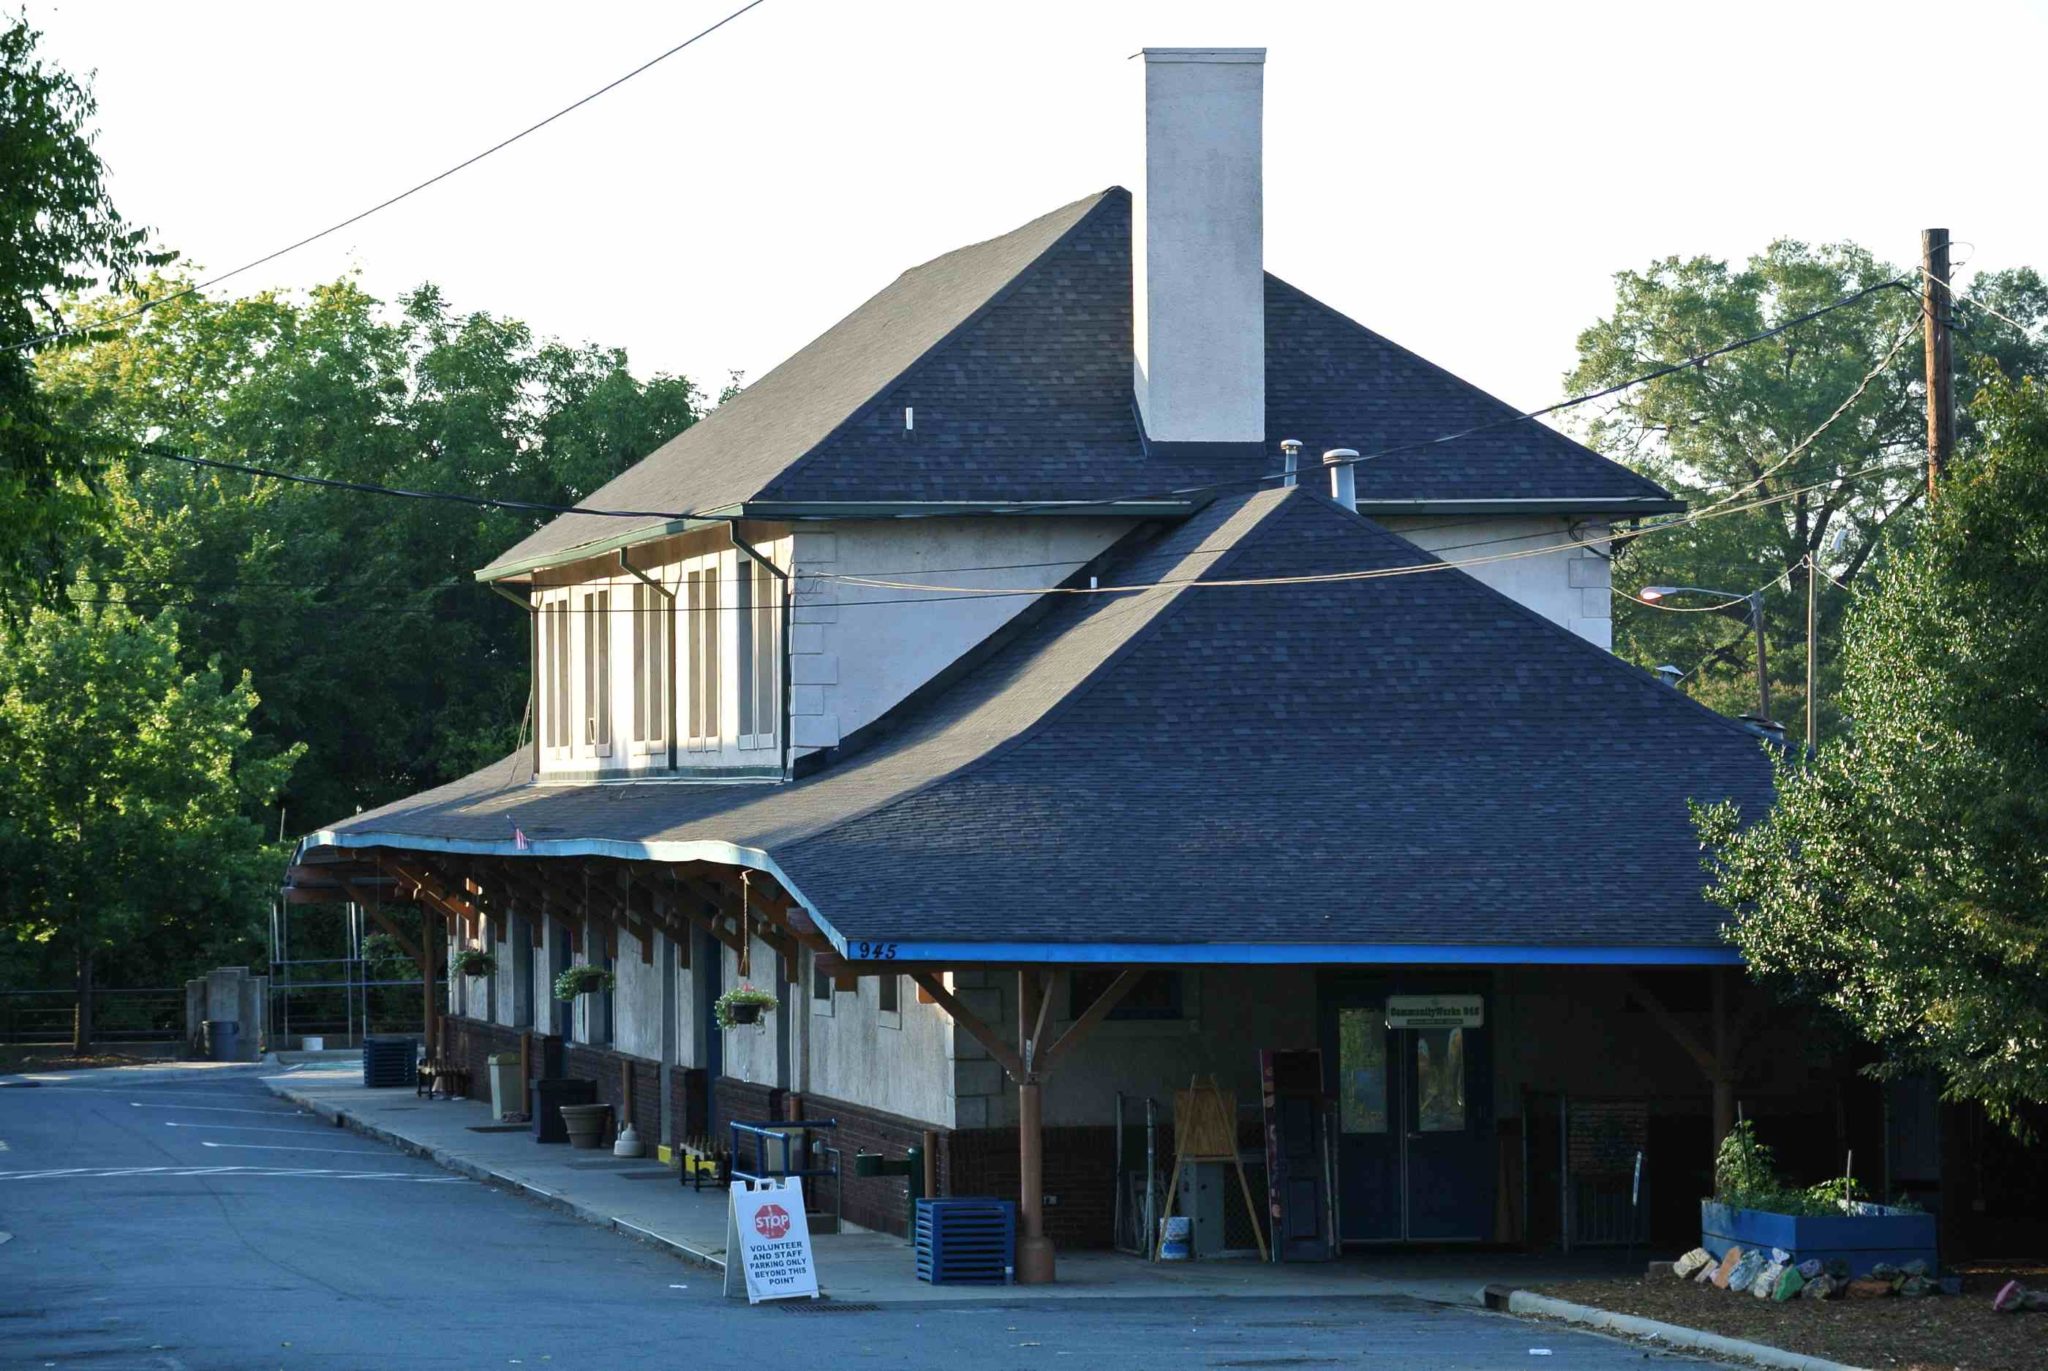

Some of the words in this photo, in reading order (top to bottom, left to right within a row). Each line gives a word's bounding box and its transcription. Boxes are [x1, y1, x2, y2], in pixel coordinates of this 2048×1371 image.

[859, 941, 898, 959] 945
[756, 1215, 789, 1228] STOP
[750, 1241, 803, 1252] VOLUNTEER
[753, 1252, 772, 1261] AND
[775, 1250, 802, 1259] STAFF
[750, 1260, 784, 1270] PARKING
[786, 1258, 807, 1266] ONLY
[755, 1269, 787, 1279] BEYOND
[789, 1267, 807, 1275] THIS
[769, 1277, 795, 1285] POINT
